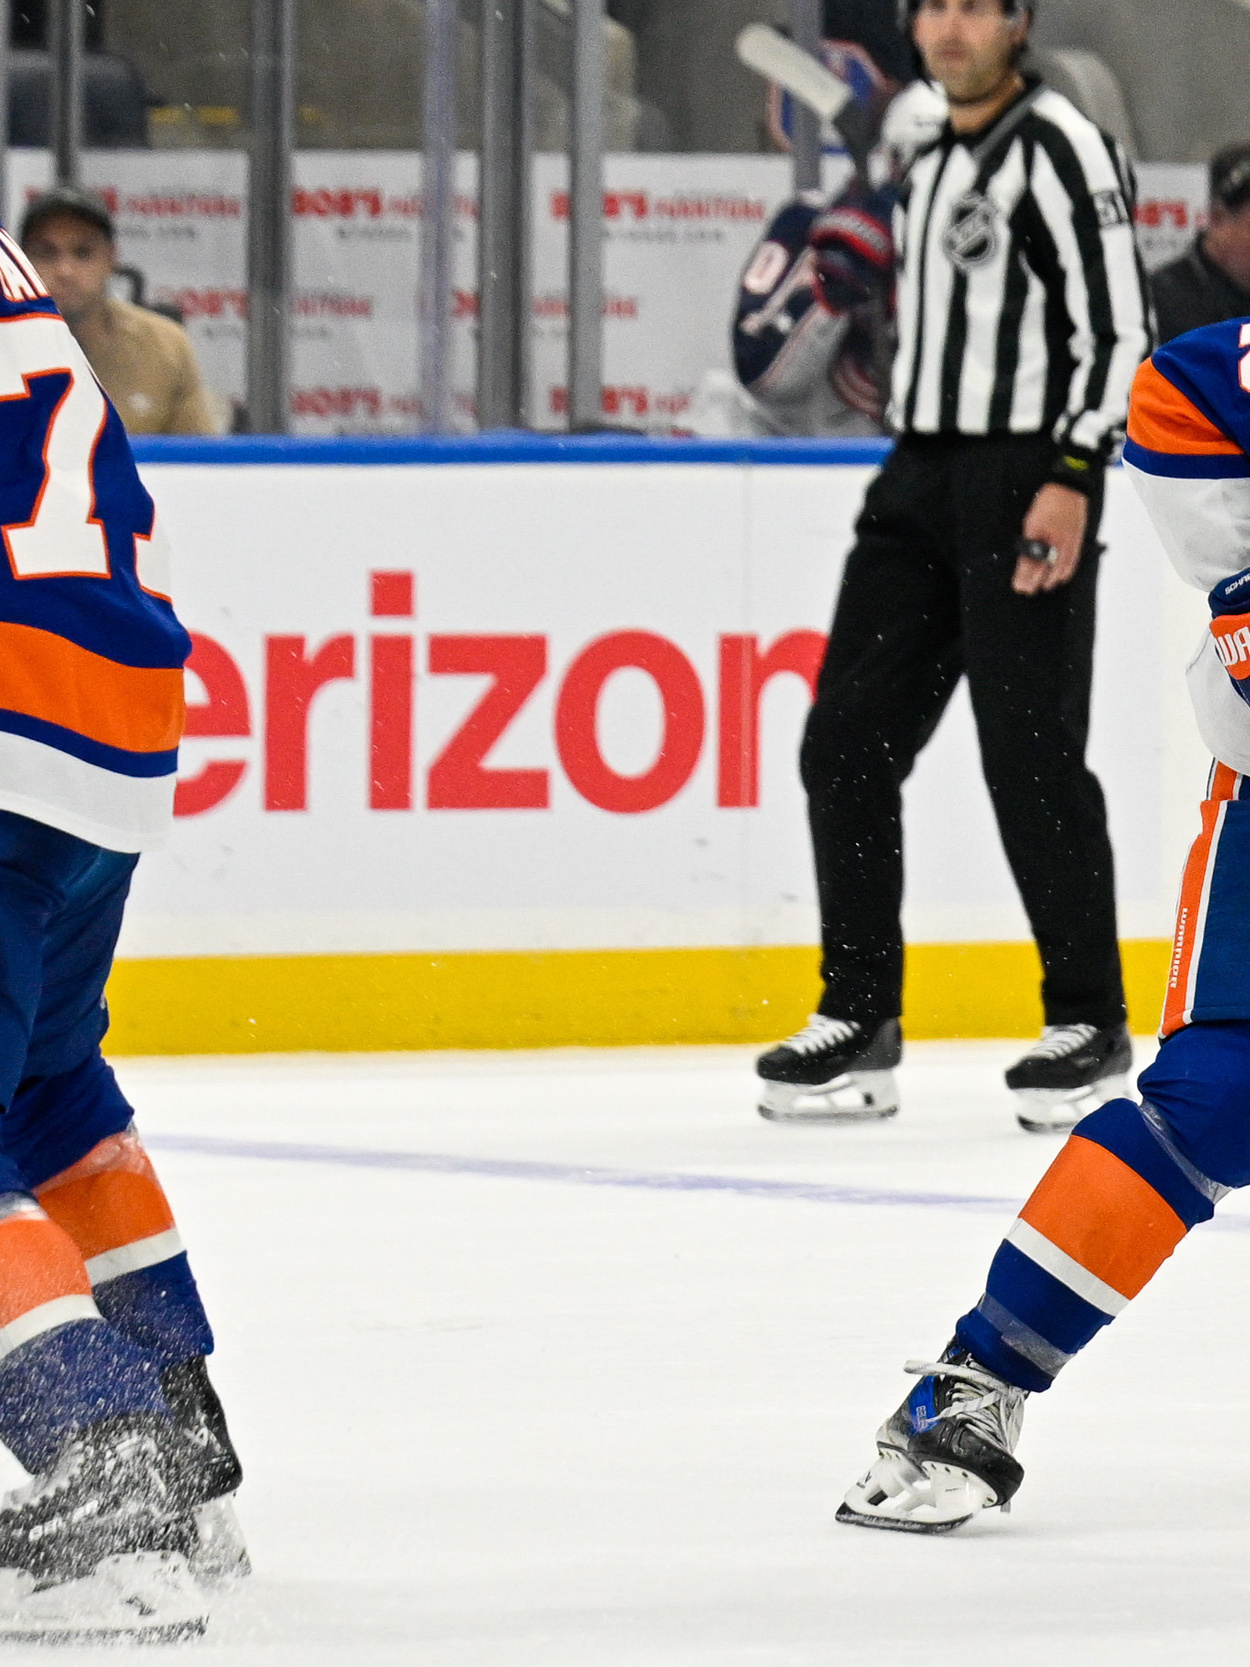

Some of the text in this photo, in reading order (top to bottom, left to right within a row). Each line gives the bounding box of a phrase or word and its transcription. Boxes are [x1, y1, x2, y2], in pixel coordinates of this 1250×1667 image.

[552, 191, 648, 219] BB'S
[171, 569, 829, 817] erizon
[1170, 907, 1188, 989] WARRIOR
